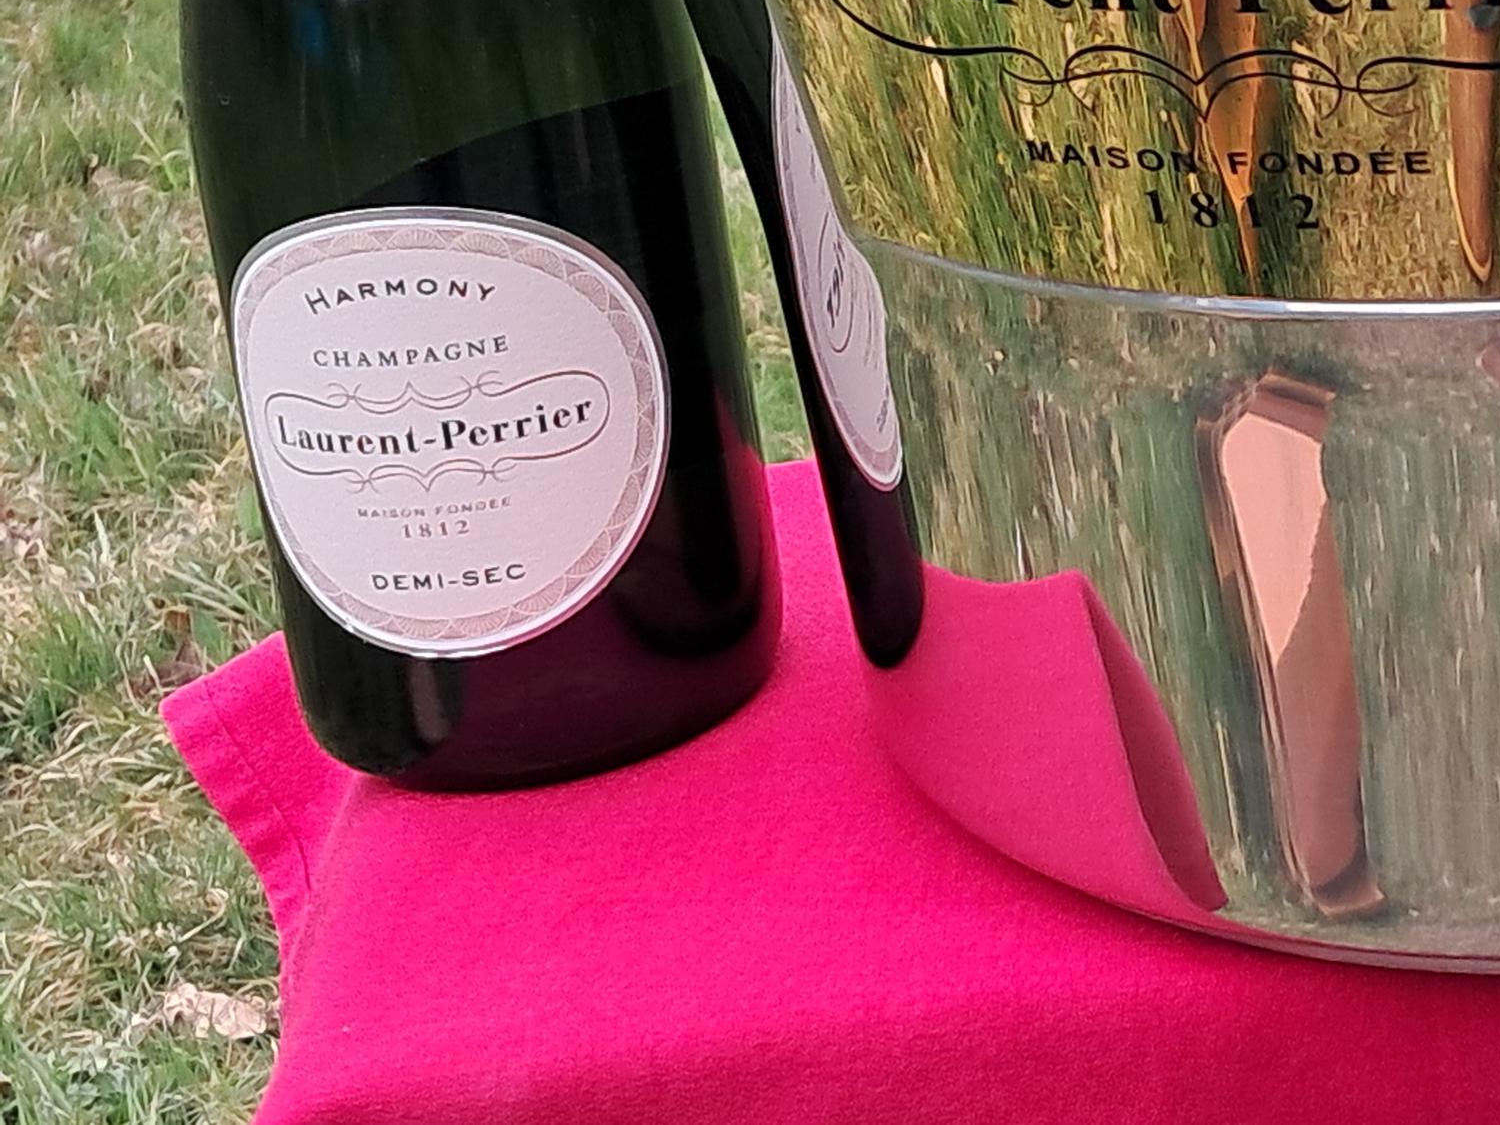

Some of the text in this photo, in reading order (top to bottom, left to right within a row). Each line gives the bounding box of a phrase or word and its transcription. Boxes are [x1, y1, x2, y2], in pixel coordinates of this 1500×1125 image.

[1027, 139, 1431, 176] MAISON FONDÉE
[1145, 189, 1319, 229] 1812
[304, 278, 496, 315] HARMONY
[313, 335, 509, 368] CHAMPAGNE
[277, 399, 593, 455] Laurent-Perrier
[358, 508, 426, 518] MAISON
[402, 520, 470, 538] 1812
[371, 564, 526, 590] DEMI-SEC
